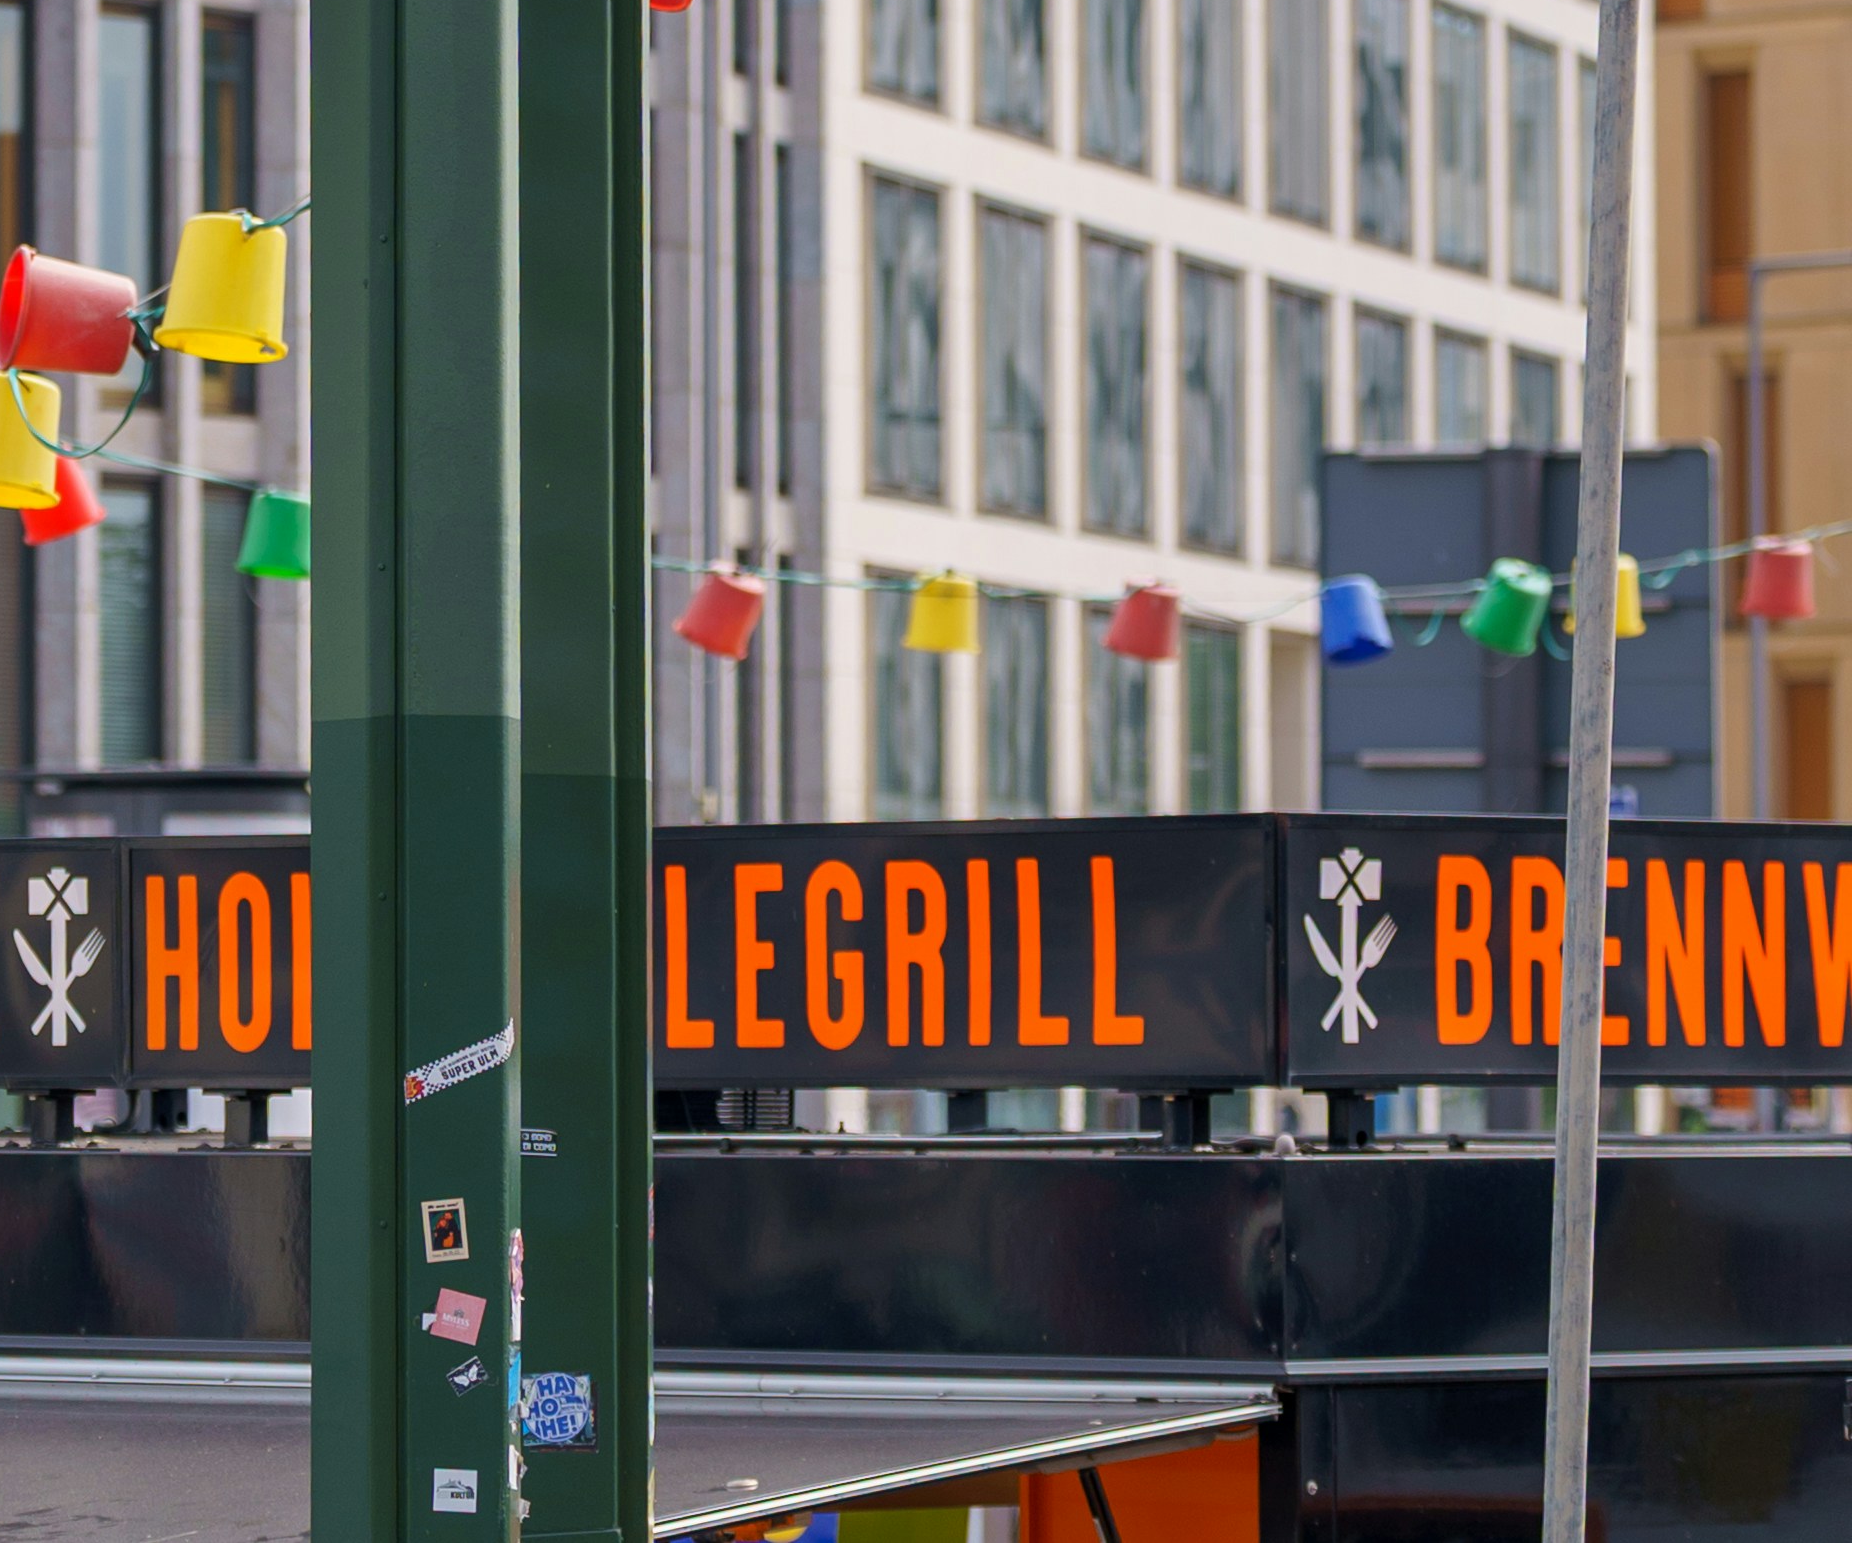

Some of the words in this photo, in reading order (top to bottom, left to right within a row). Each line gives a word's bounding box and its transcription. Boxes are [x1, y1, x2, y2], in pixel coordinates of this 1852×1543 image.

[440, 1059, 477, 1081] SUPER
[477, 1048, 499, 1067] ULM
[540, 1414, 578, 1438] HE!
